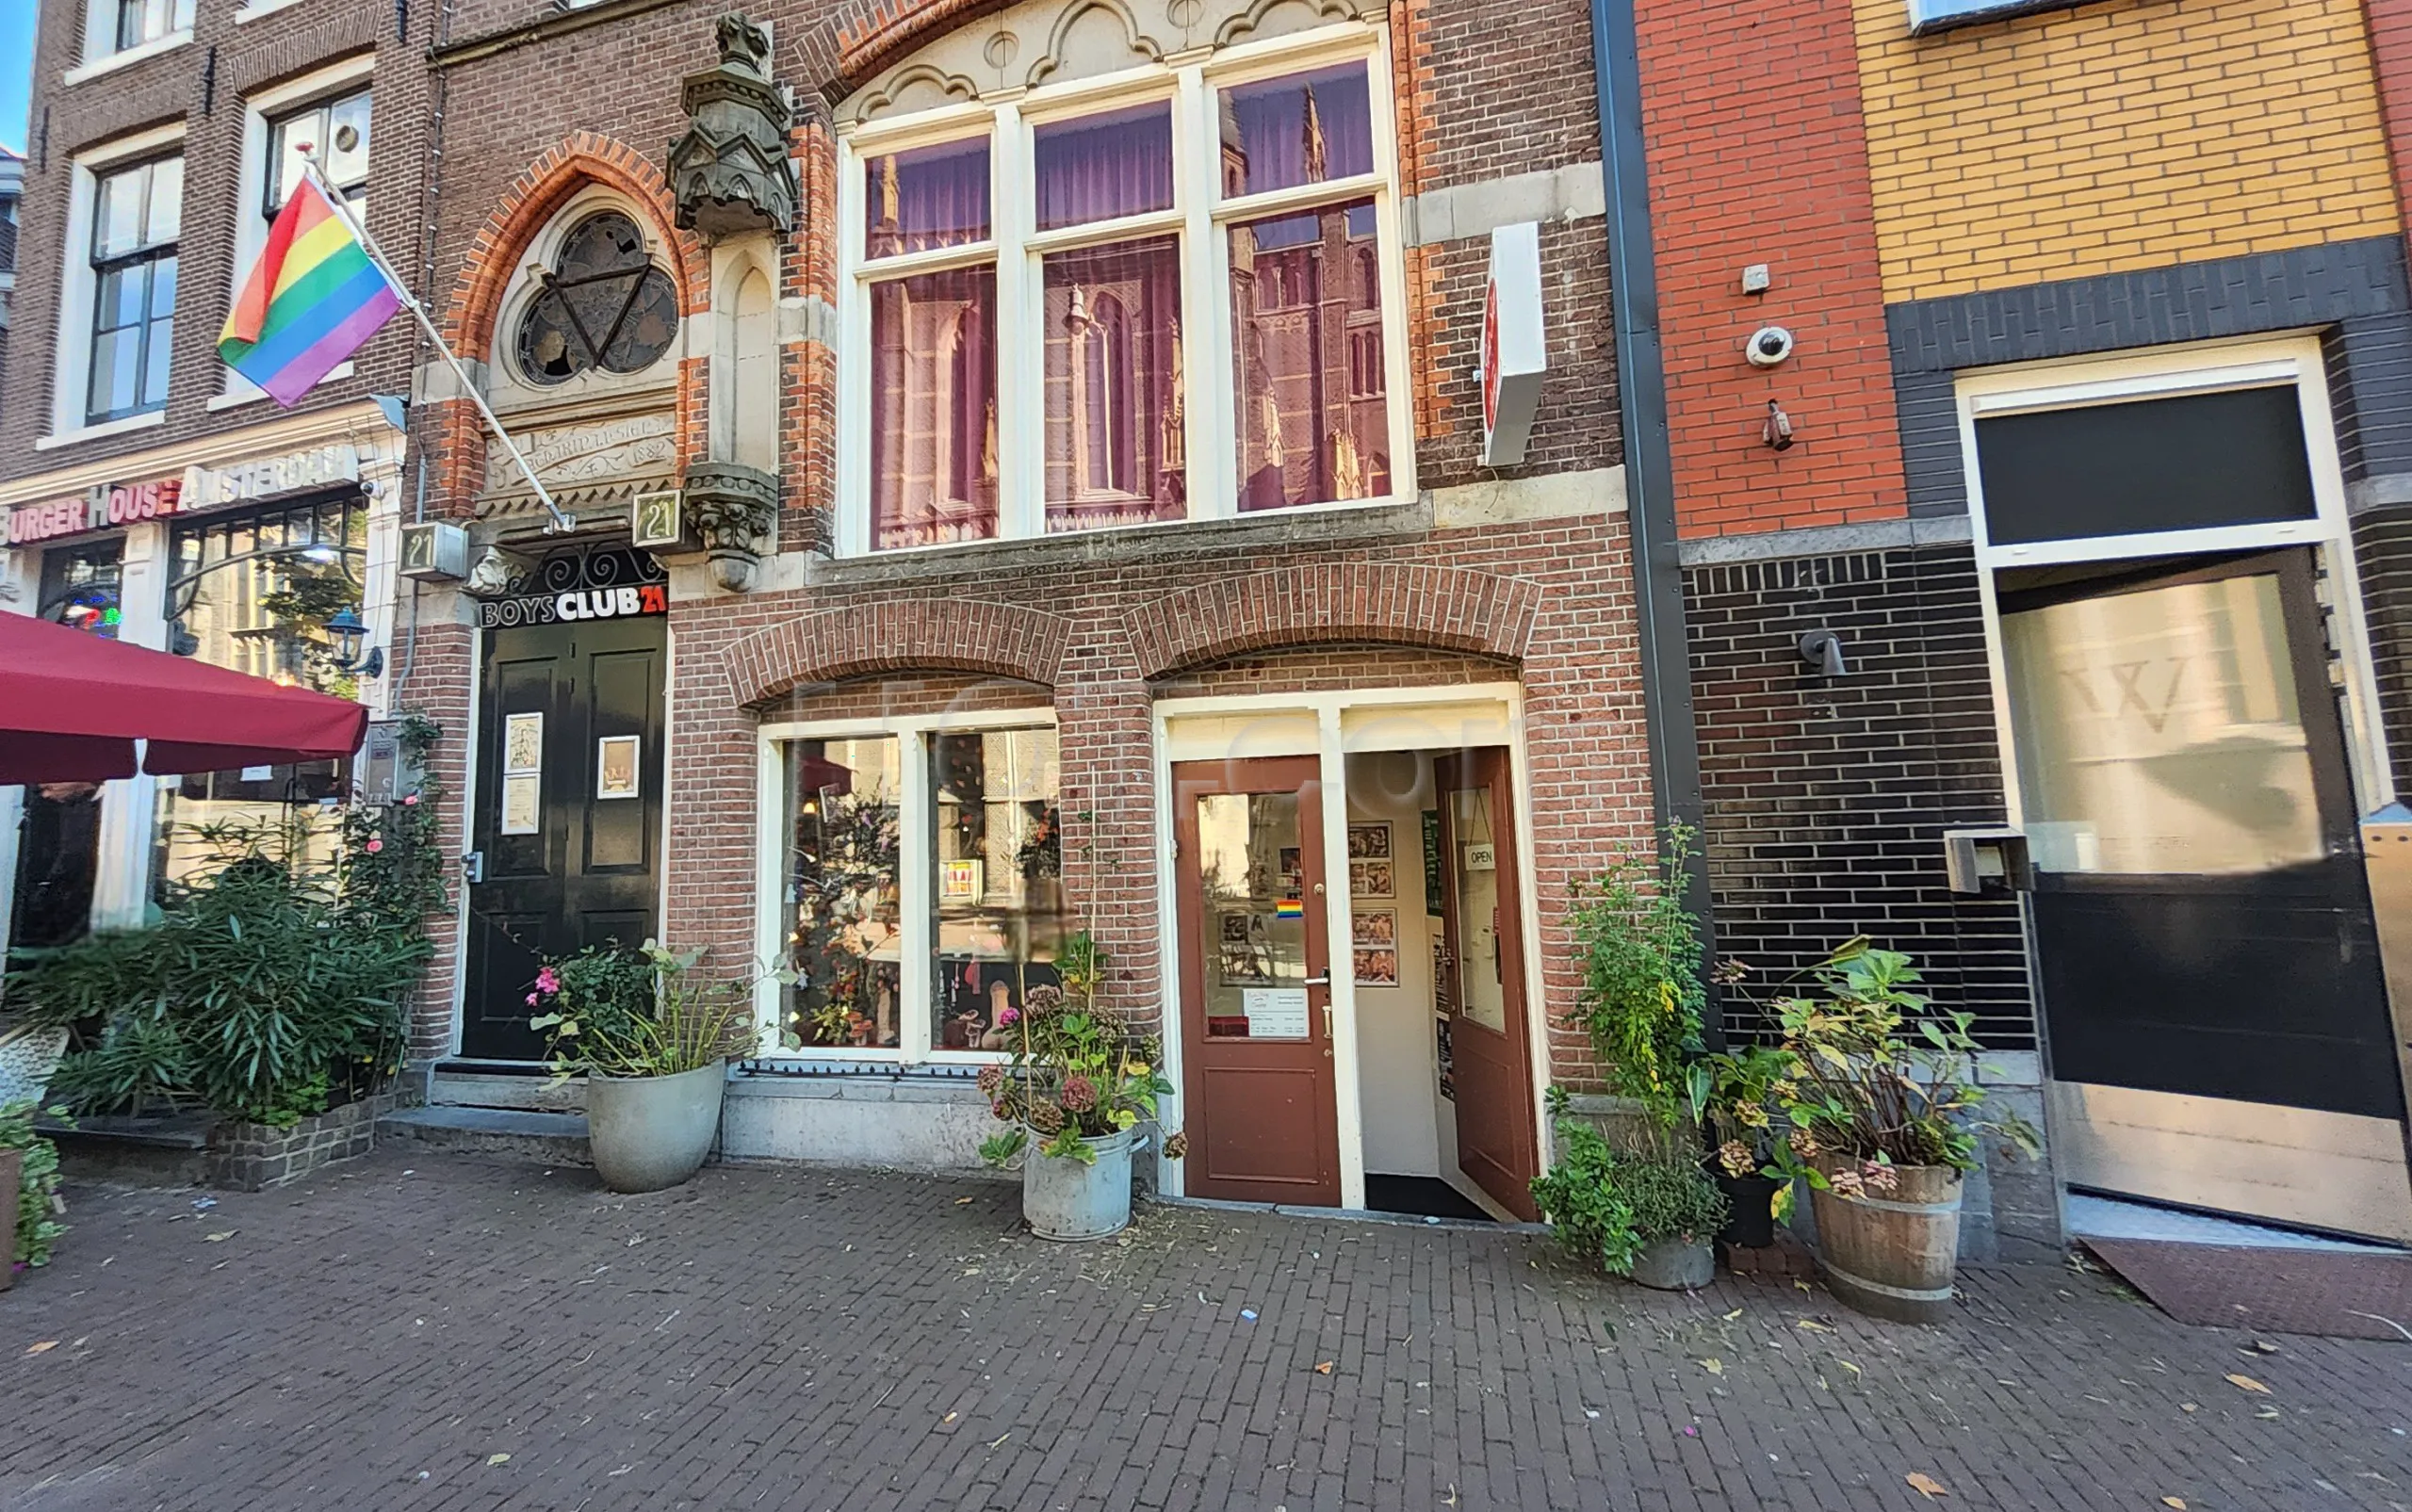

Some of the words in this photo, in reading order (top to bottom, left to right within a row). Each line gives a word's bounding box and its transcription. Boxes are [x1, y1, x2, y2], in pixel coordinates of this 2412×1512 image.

[88, 481, 180, 528] HOUSE
[647, 504, 671, 540] 21
[409, 533, 433, 567] 21
[1471, 851, 1492, 864] OPEN
